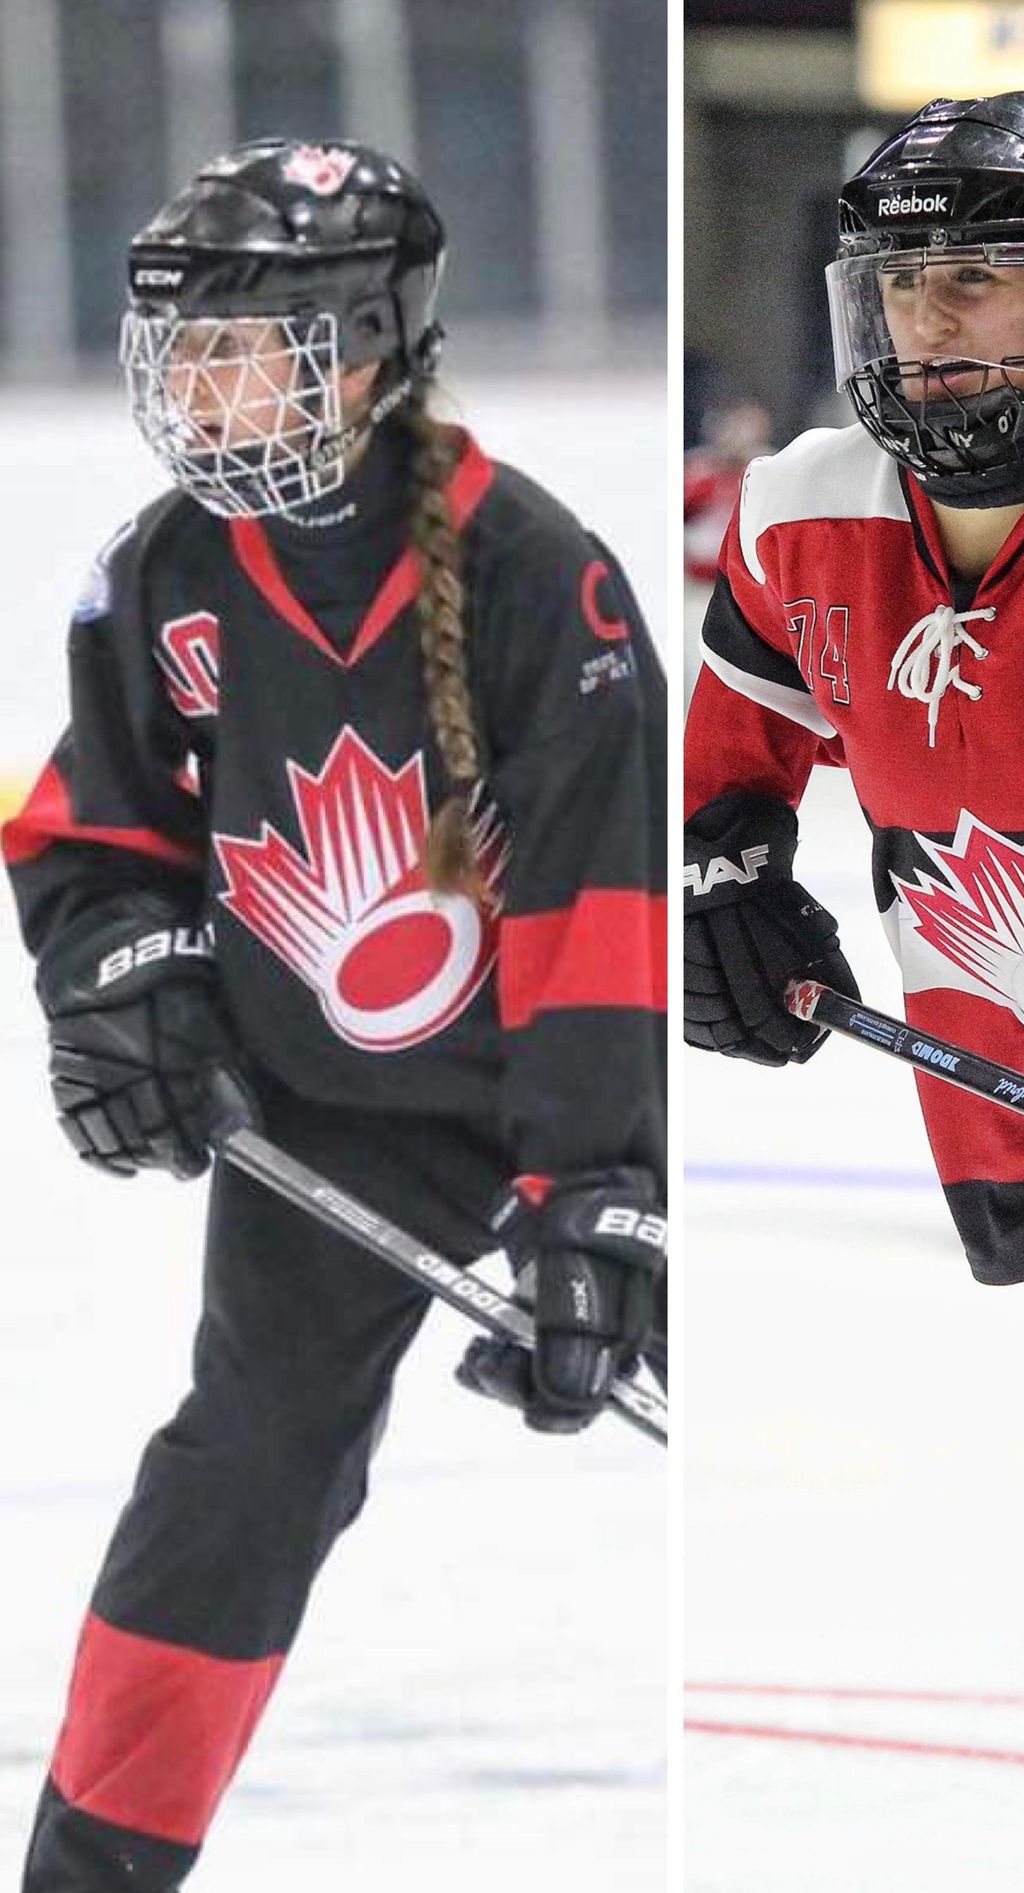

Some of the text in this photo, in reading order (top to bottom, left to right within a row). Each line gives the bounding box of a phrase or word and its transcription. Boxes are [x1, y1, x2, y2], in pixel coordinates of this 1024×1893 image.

[878, 194, 948, 217] Reebok
[135, 269, 183, 286] CCM
[783, 598, 851, 704] 74
[96, 922, 215, 988] BAU
[594, 1206, 667, 1257] BA
